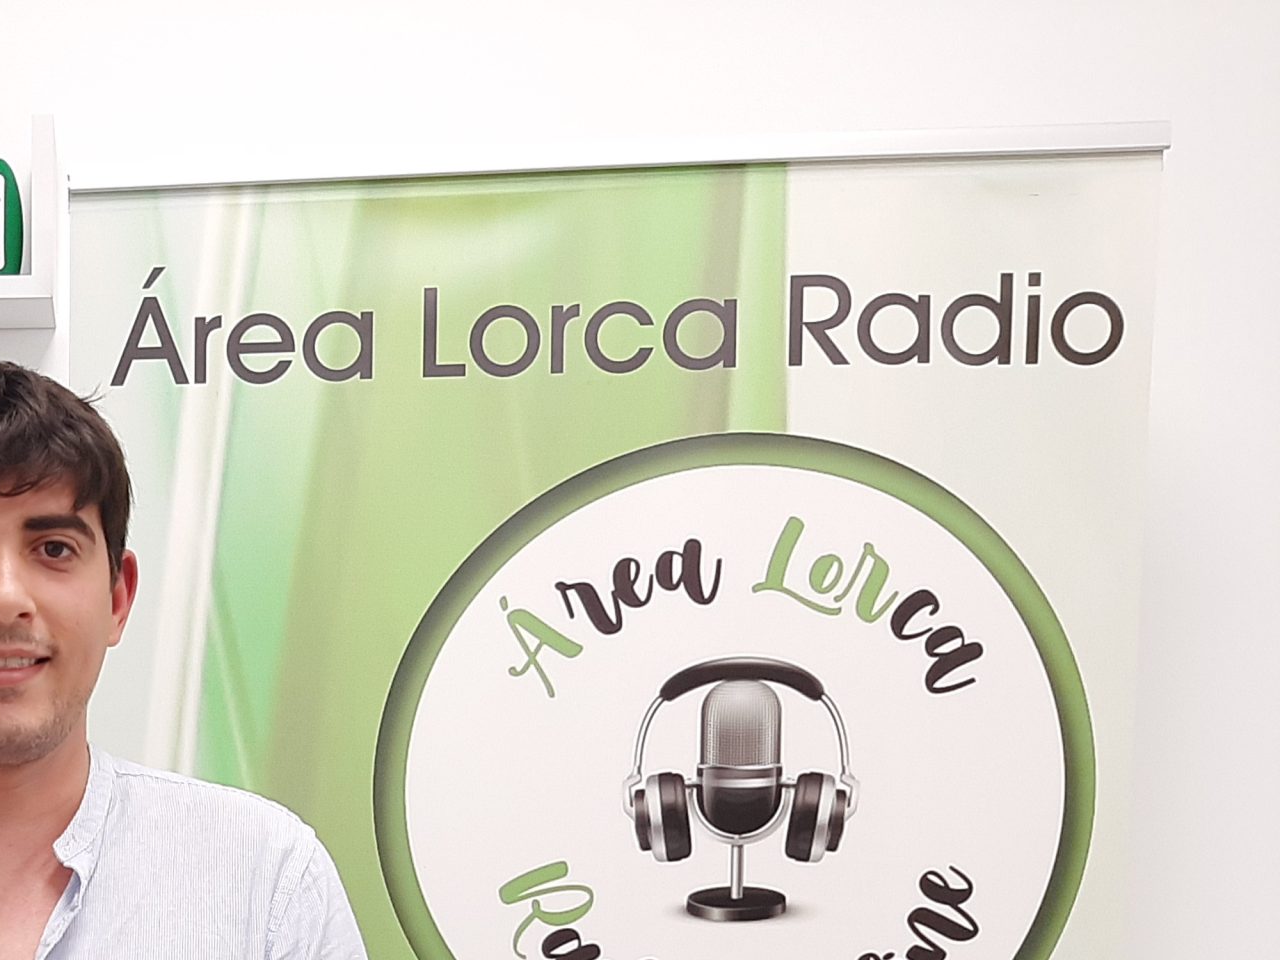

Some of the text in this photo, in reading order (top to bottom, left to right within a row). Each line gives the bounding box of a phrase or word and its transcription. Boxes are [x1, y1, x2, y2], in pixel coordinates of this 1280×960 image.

[109, 266, 1125, 387] Área Lorca Radio
[499, 516, 984, 700] Área Lorca
